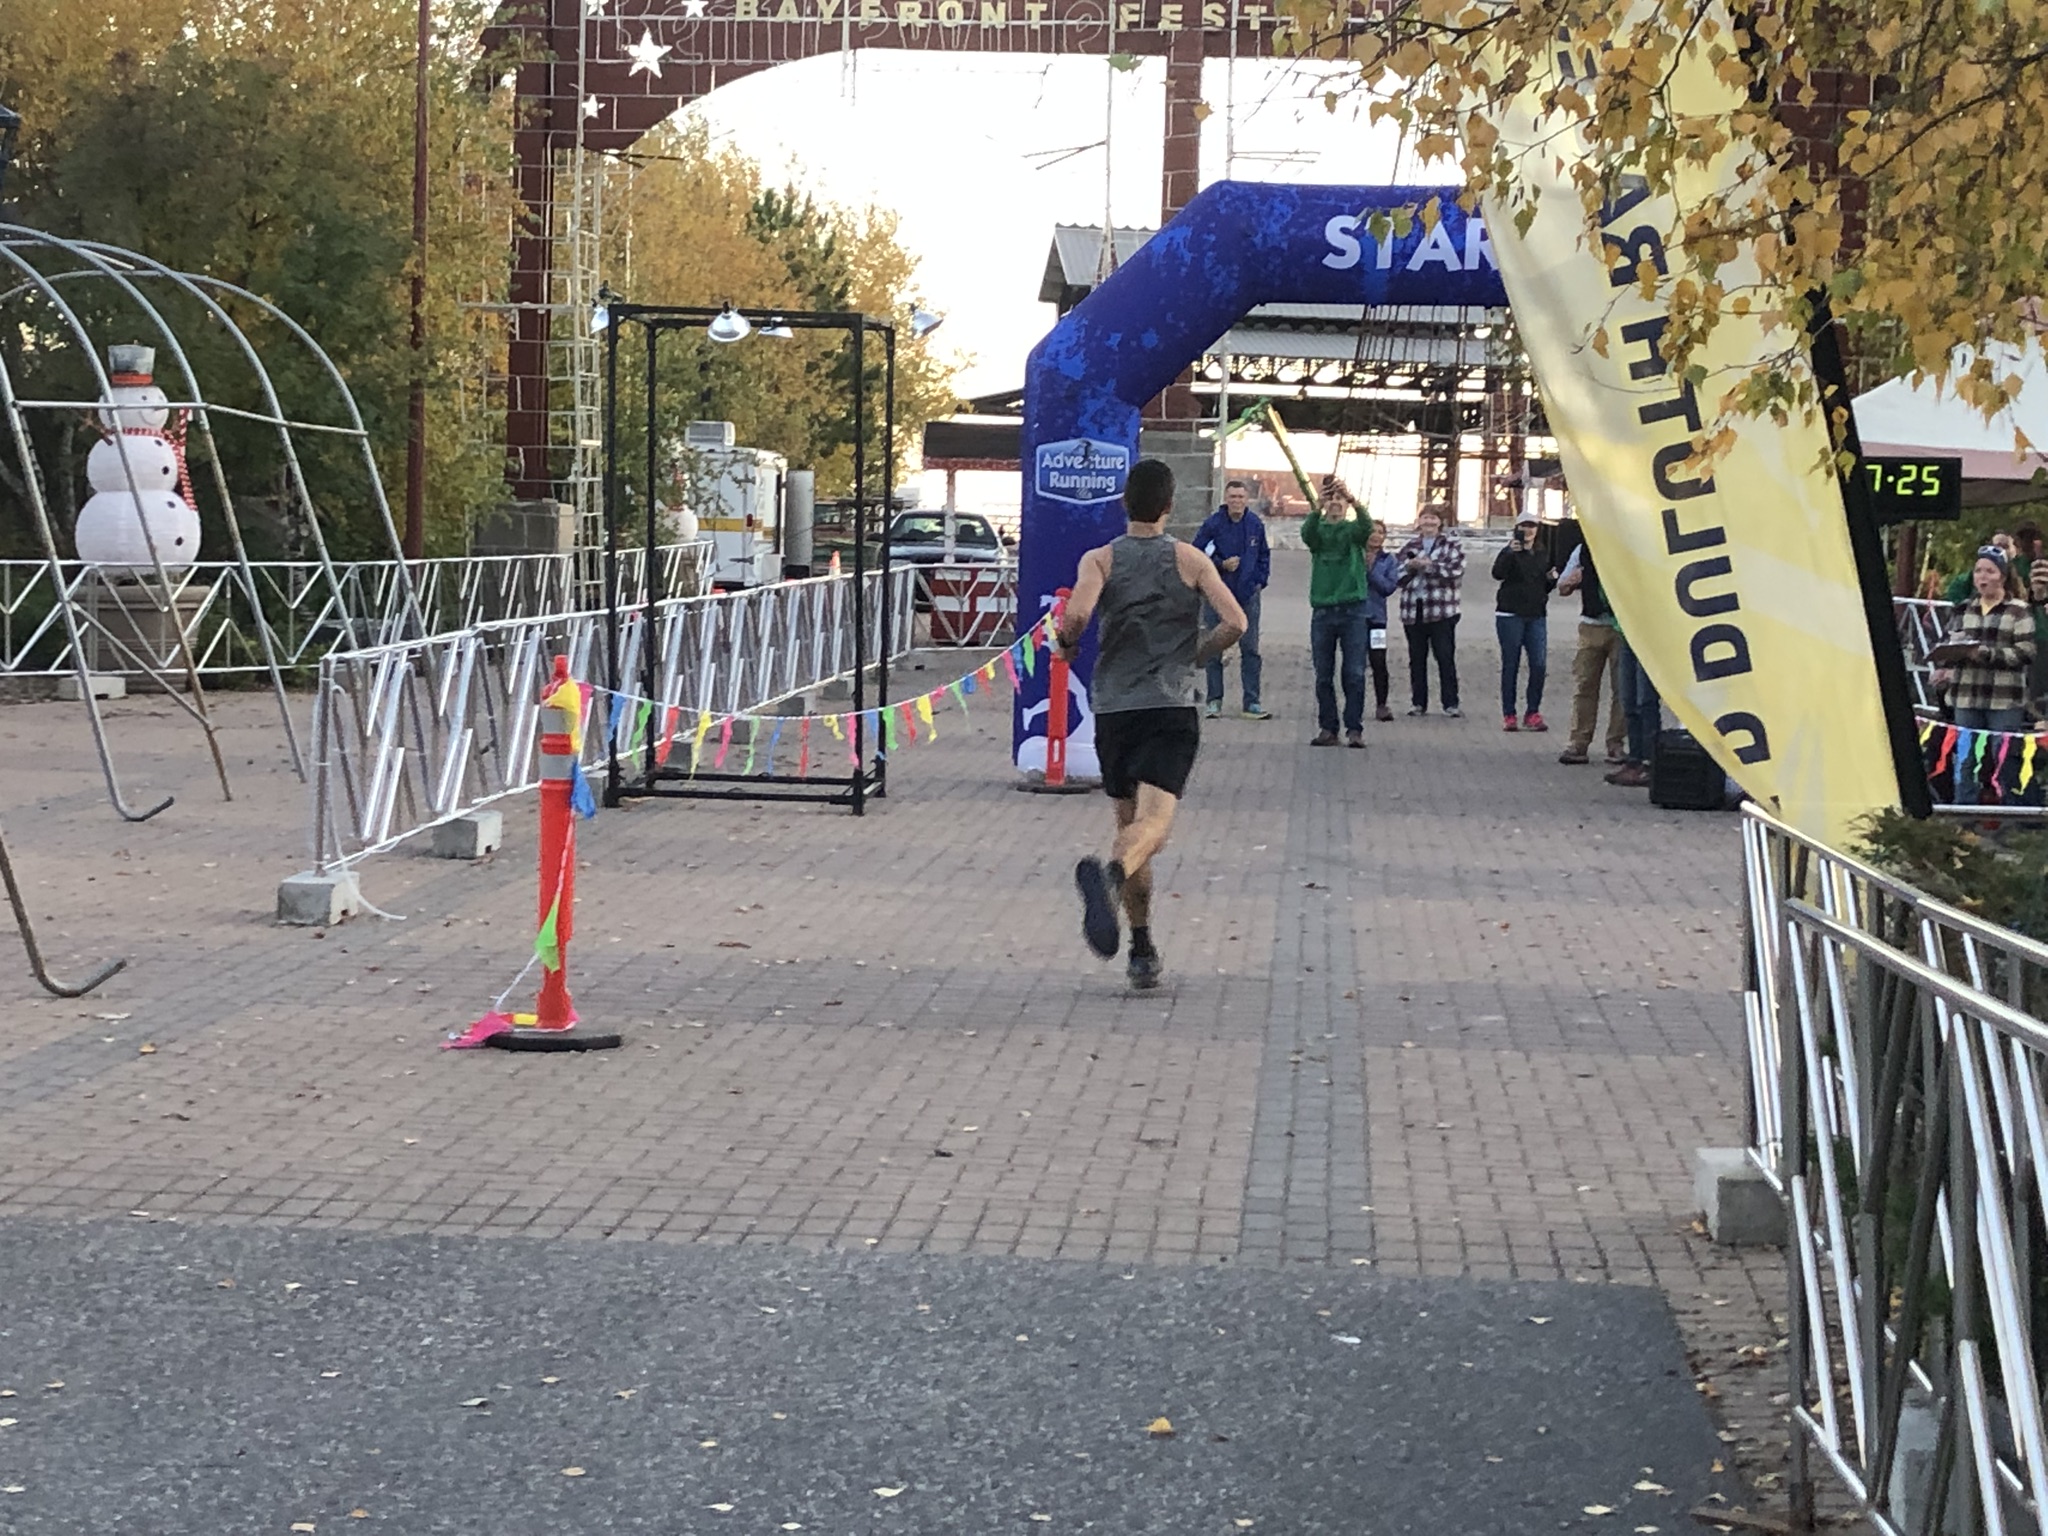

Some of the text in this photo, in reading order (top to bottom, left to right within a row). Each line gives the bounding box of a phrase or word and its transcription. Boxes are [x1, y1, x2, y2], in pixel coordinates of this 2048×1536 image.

[735, 0, 1047, 29] BAYFRONT
[1322, 214, 1500, 272] STAR
[1049, 471, 1116, 493] Running
